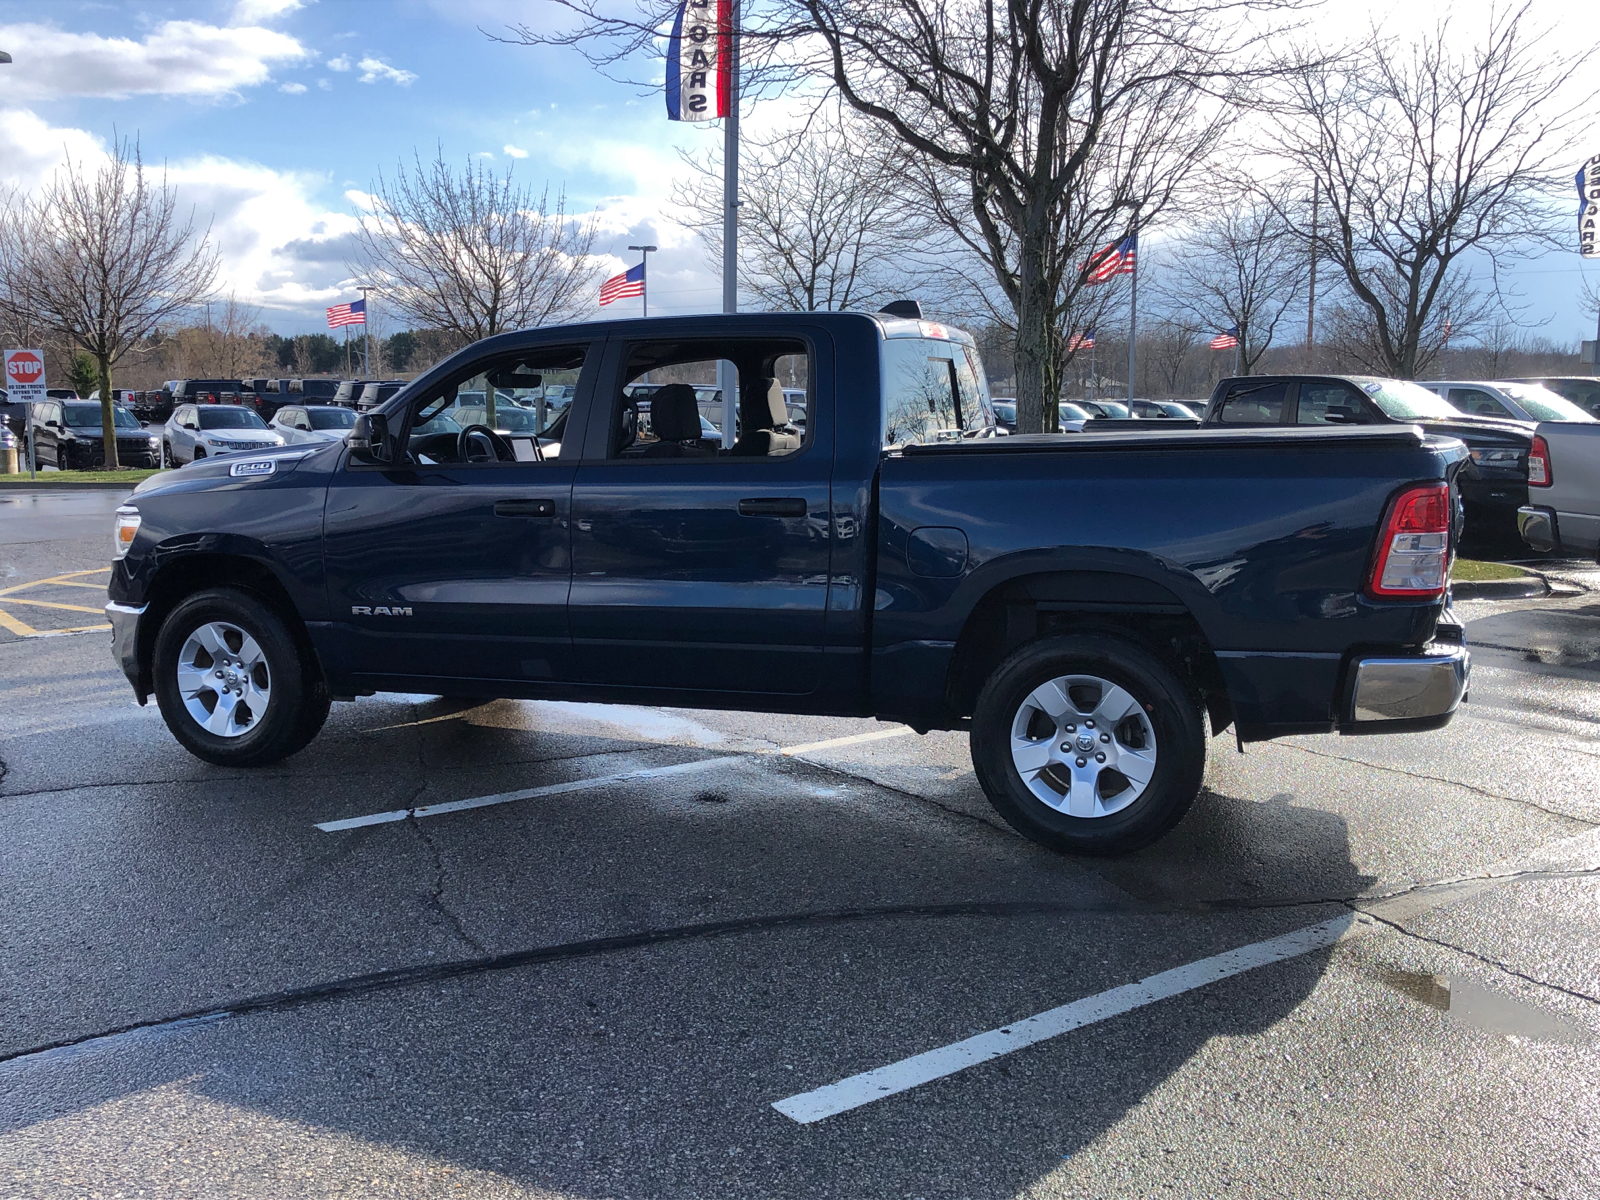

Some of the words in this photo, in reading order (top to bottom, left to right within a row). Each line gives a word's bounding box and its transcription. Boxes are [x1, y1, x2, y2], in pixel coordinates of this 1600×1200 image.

[8, 361, 41, 374] STOP
[237, 463, 271, 471] 1500
[351, 605, 413, 616] RAM
